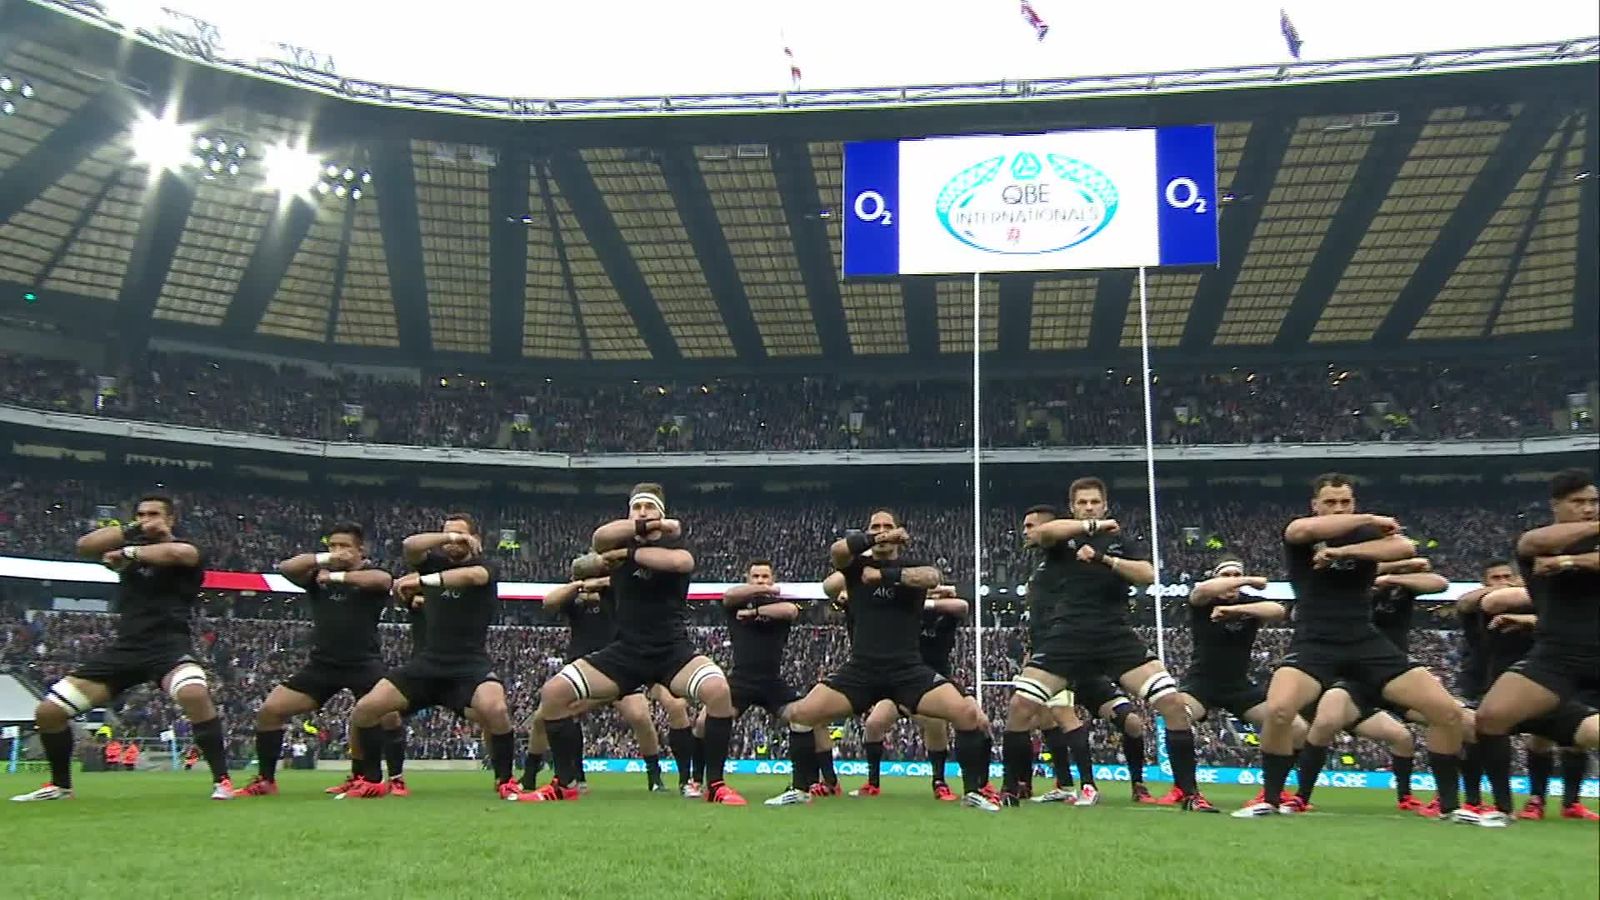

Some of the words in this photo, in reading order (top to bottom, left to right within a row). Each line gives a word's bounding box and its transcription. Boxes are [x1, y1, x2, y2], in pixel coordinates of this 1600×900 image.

[1001, 184, 1050, 205] QBE
[956, 207, 1099, 225] INTERNATIONALS
[1332, 772, 1367, 788] QBE
